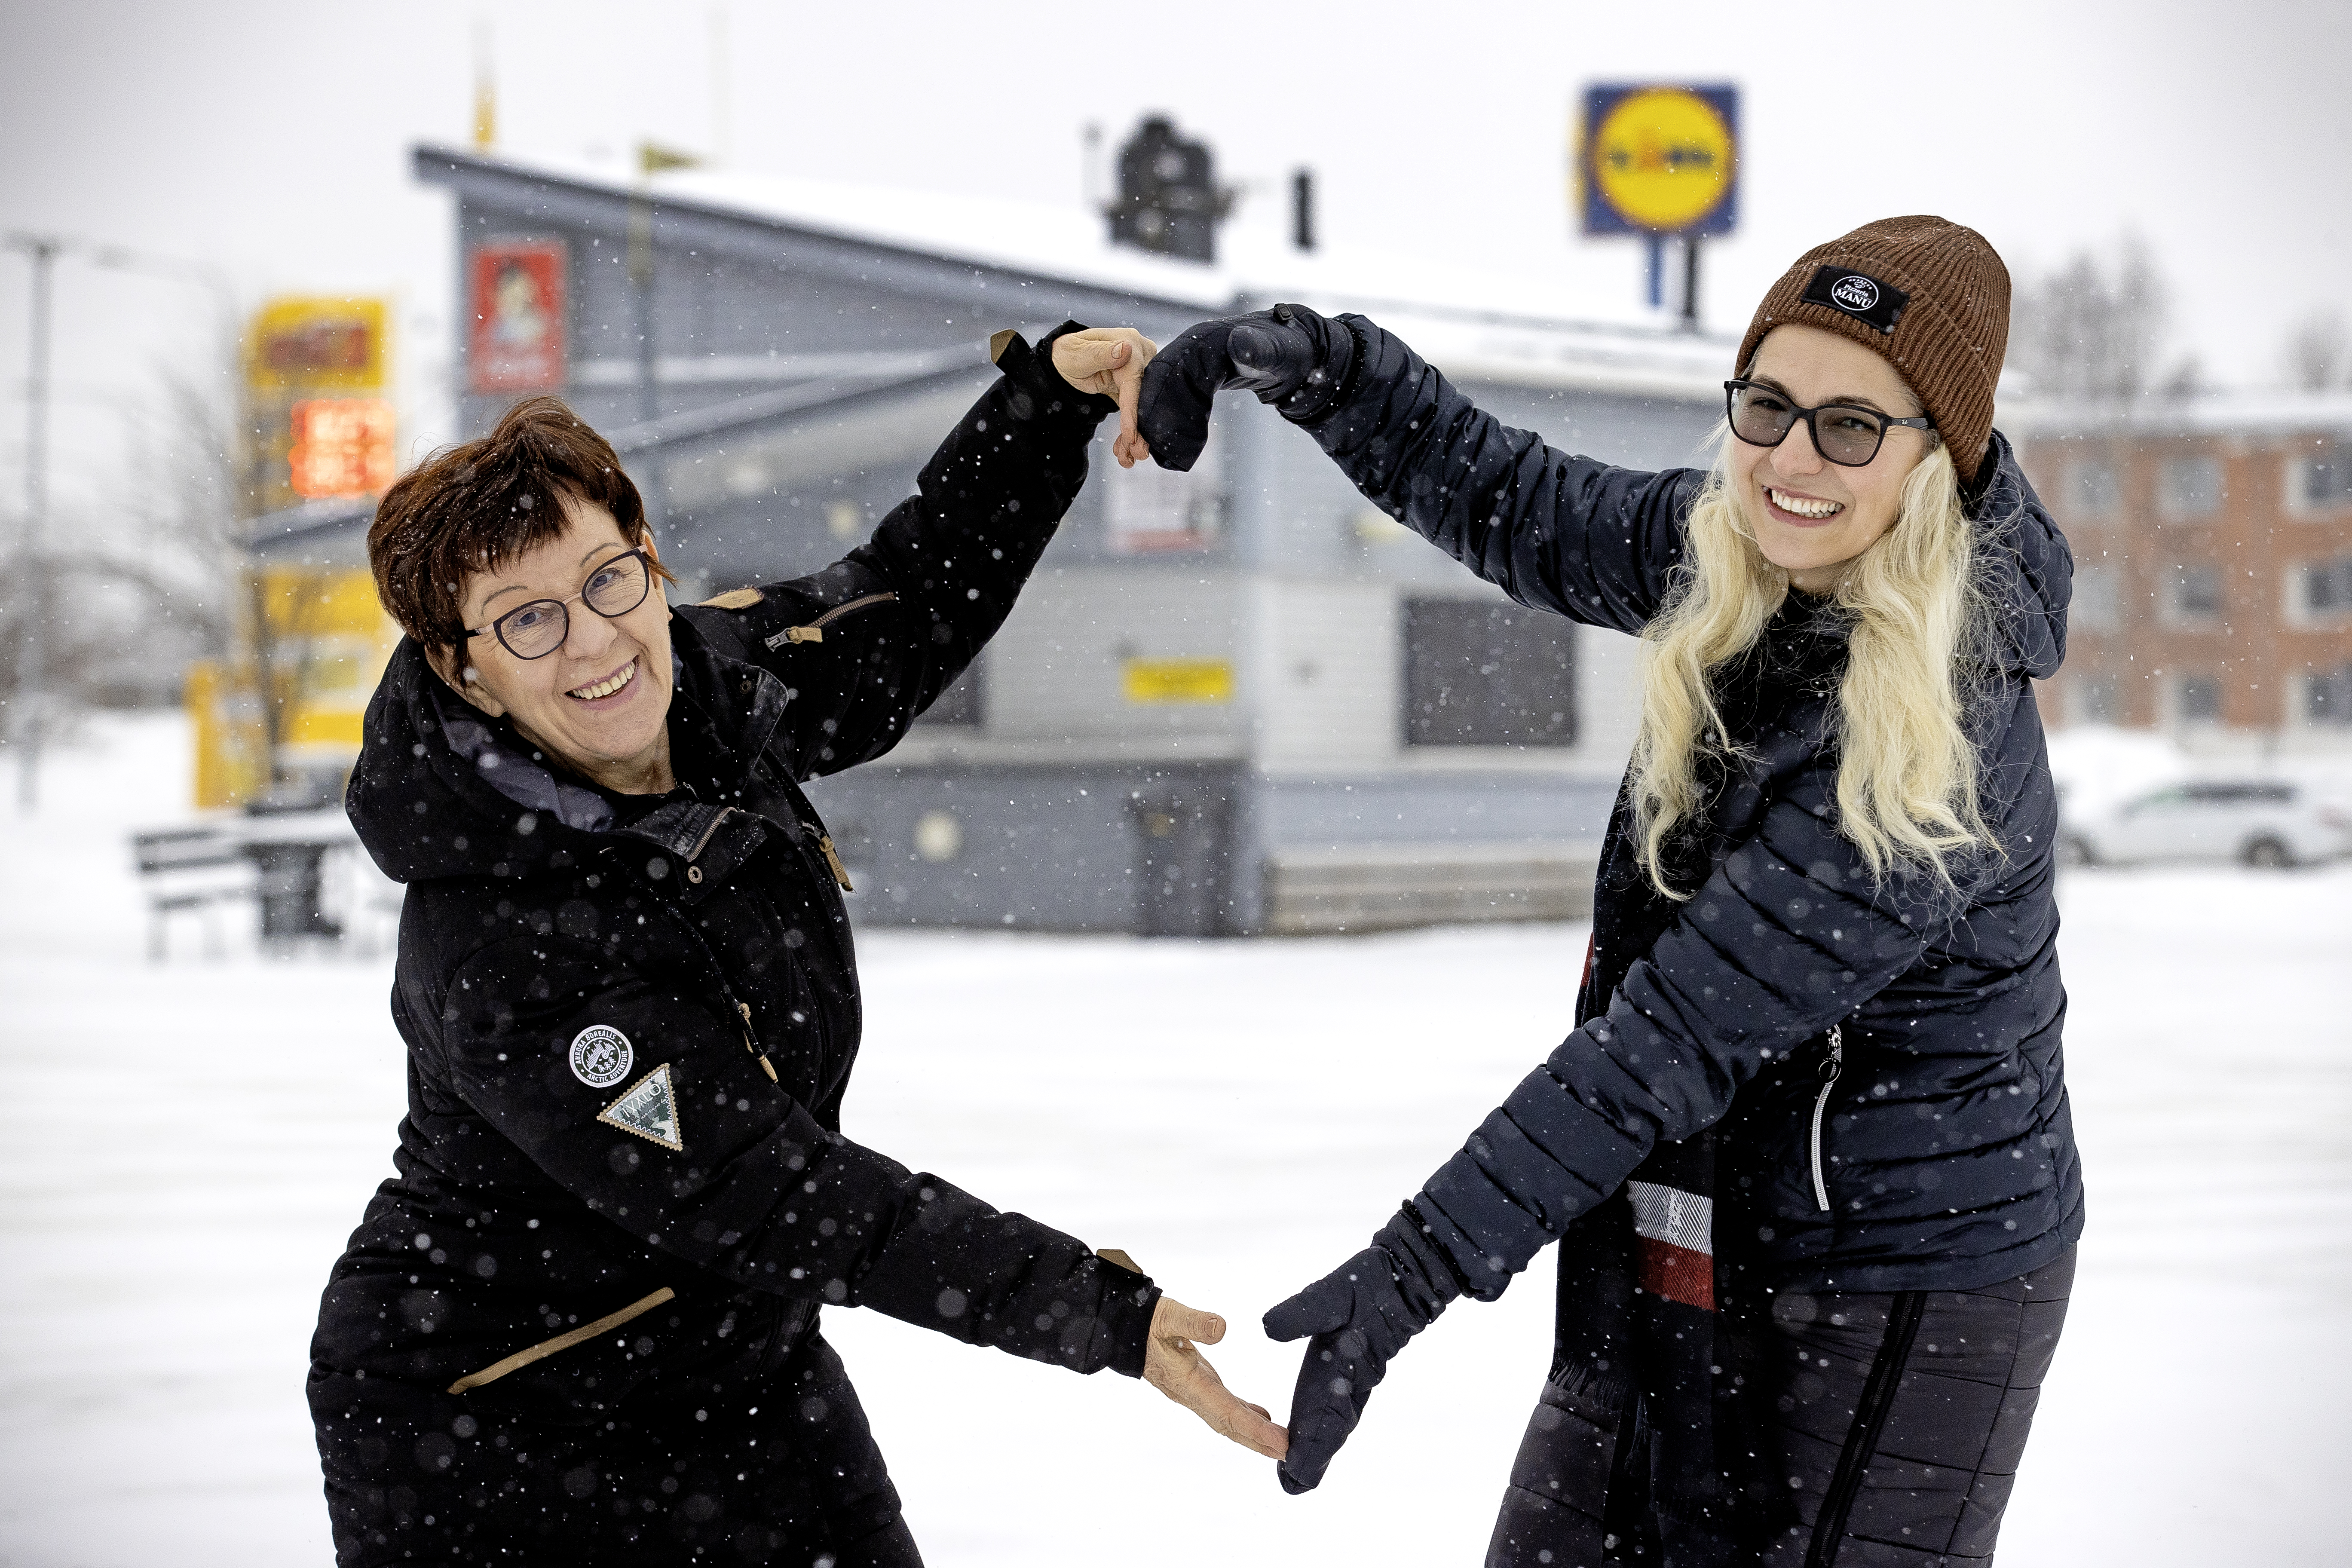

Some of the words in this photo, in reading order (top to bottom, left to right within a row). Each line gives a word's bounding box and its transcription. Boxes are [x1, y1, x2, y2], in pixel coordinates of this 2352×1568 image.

[1834, 289, 1872, 307] MANU
[1844, 284, 1868, 297] Pizzeria
[575, 1039, 586, 1064] AURORA
[585, 1030, 616, 1041] BOREALIS
[587, 1073, 609, 1082] ARCTIC
[609, 1050, 628, 1080] ADVENTURE
[622, 1083, 661, 1118] IXXLO
